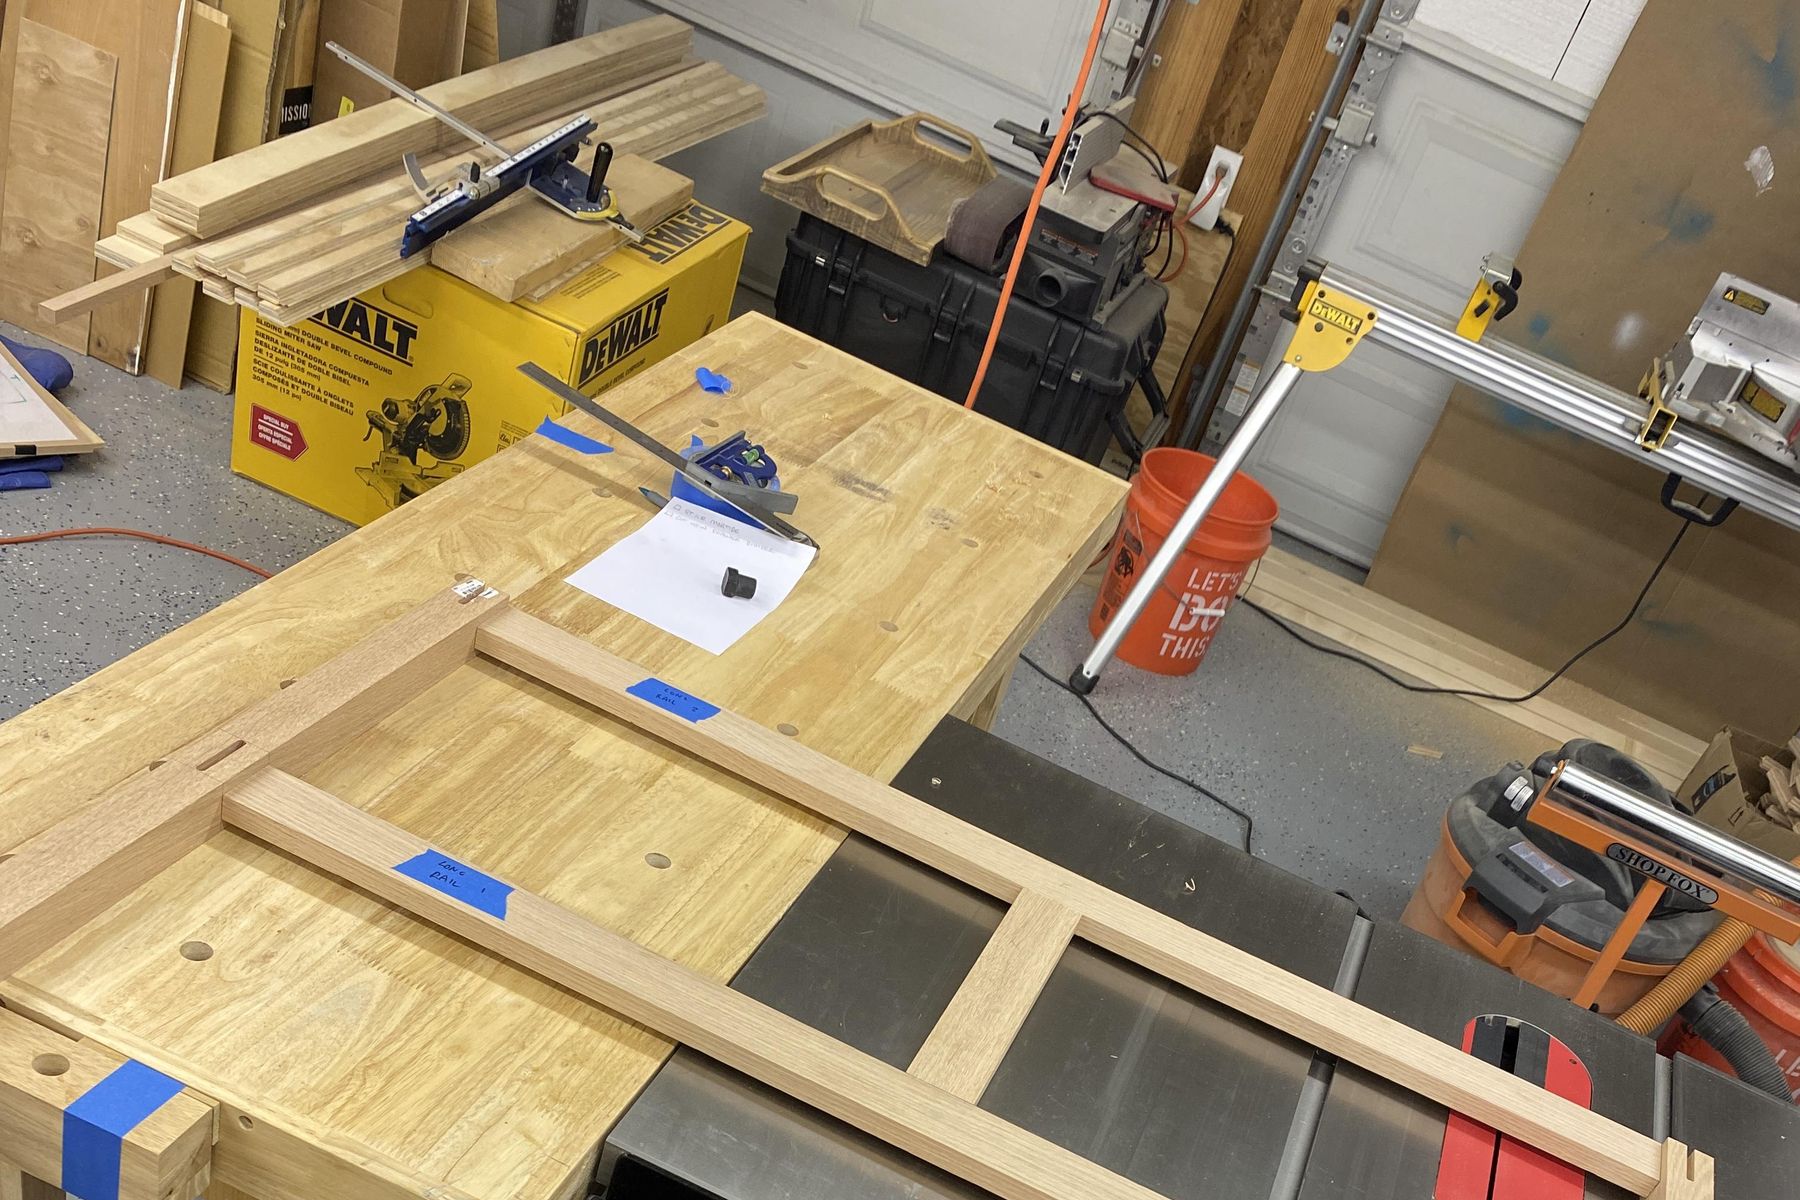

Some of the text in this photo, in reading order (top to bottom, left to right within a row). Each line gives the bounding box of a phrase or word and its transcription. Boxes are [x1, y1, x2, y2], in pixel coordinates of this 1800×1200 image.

[281, 103, 311, 123] ISSIO
[312, 298, 417, 360] WALT
[1312, 301, 1360, 330] DEWALT
[256, 317, 322, 351] SLIDING MITER SAW
[302, 327, 329, 346] DOUBLE
[330, 340, 351, 357] BEVEL
[354, 353, 393, 375] COMPOUND
[579, 293, 668, 384] DEWALT
[254, 338, 351, 386] DESLIZANTE DE DOBLE BISEL
[254, 346, 263, 354] DE
[275, 354, 289, 368] pulg
[290, 360, 305, 373] (305
[306, 369, 321, 382] mm)
[255, 329, 369, 386] SIERRA INGLETADORA COMPUESTA
[252, 374, 265, 384] 305
[266, 380, 278, 390] mm
[253, 358, 269, 370] SCIE
[270, 364, 315, 392] COULISSANTE
[323, 389, 354, 408] ONGLETS
[301, 387, 328, 404] DOUBLE
[329, 400, 354, 416] BISEAU
[1187, 568, 1242, 592] LET'S
[1169, 593, 1229, 632] DO
[429, 871, 460, 888] RAIL
[1616, 848, 1666, 876] SHOP
